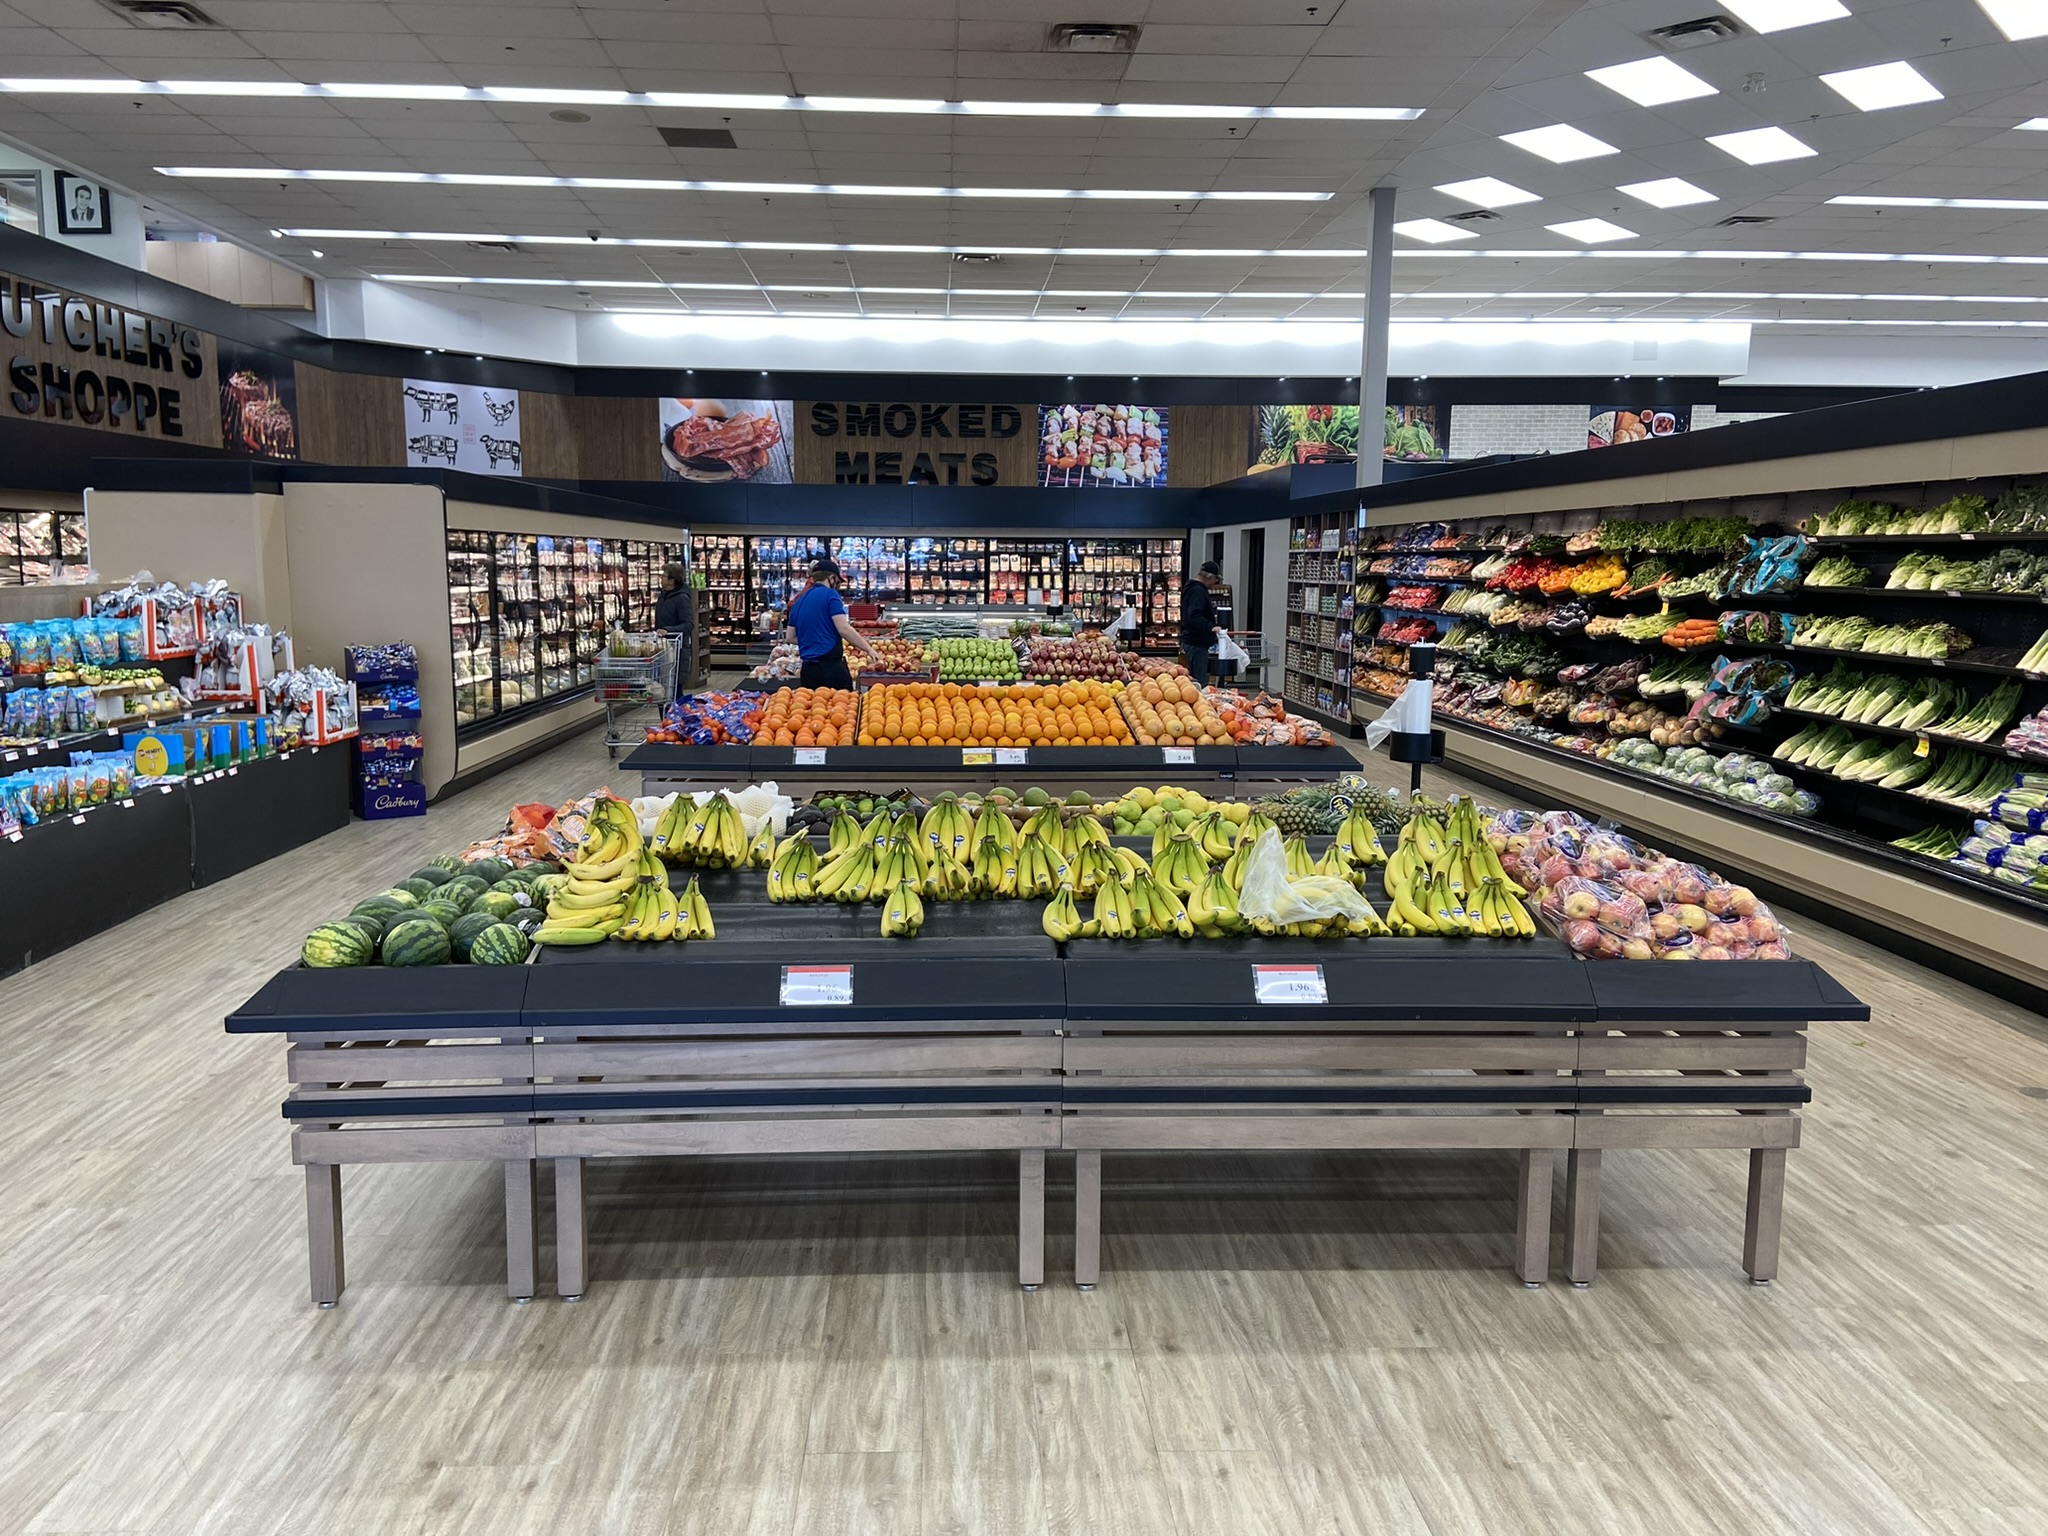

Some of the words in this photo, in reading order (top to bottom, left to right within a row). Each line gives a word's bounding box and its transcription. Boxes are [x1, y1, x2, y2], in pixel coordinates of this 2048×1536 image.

[10, 355, 183, 437] SHOPPE
[811, 402, 1022, 439] SMOKED
[834, 451, 999, 486] MEATS
[374, 794, 420, 810] Cadbury
[1289, 983, 1310, 992] 1.96
